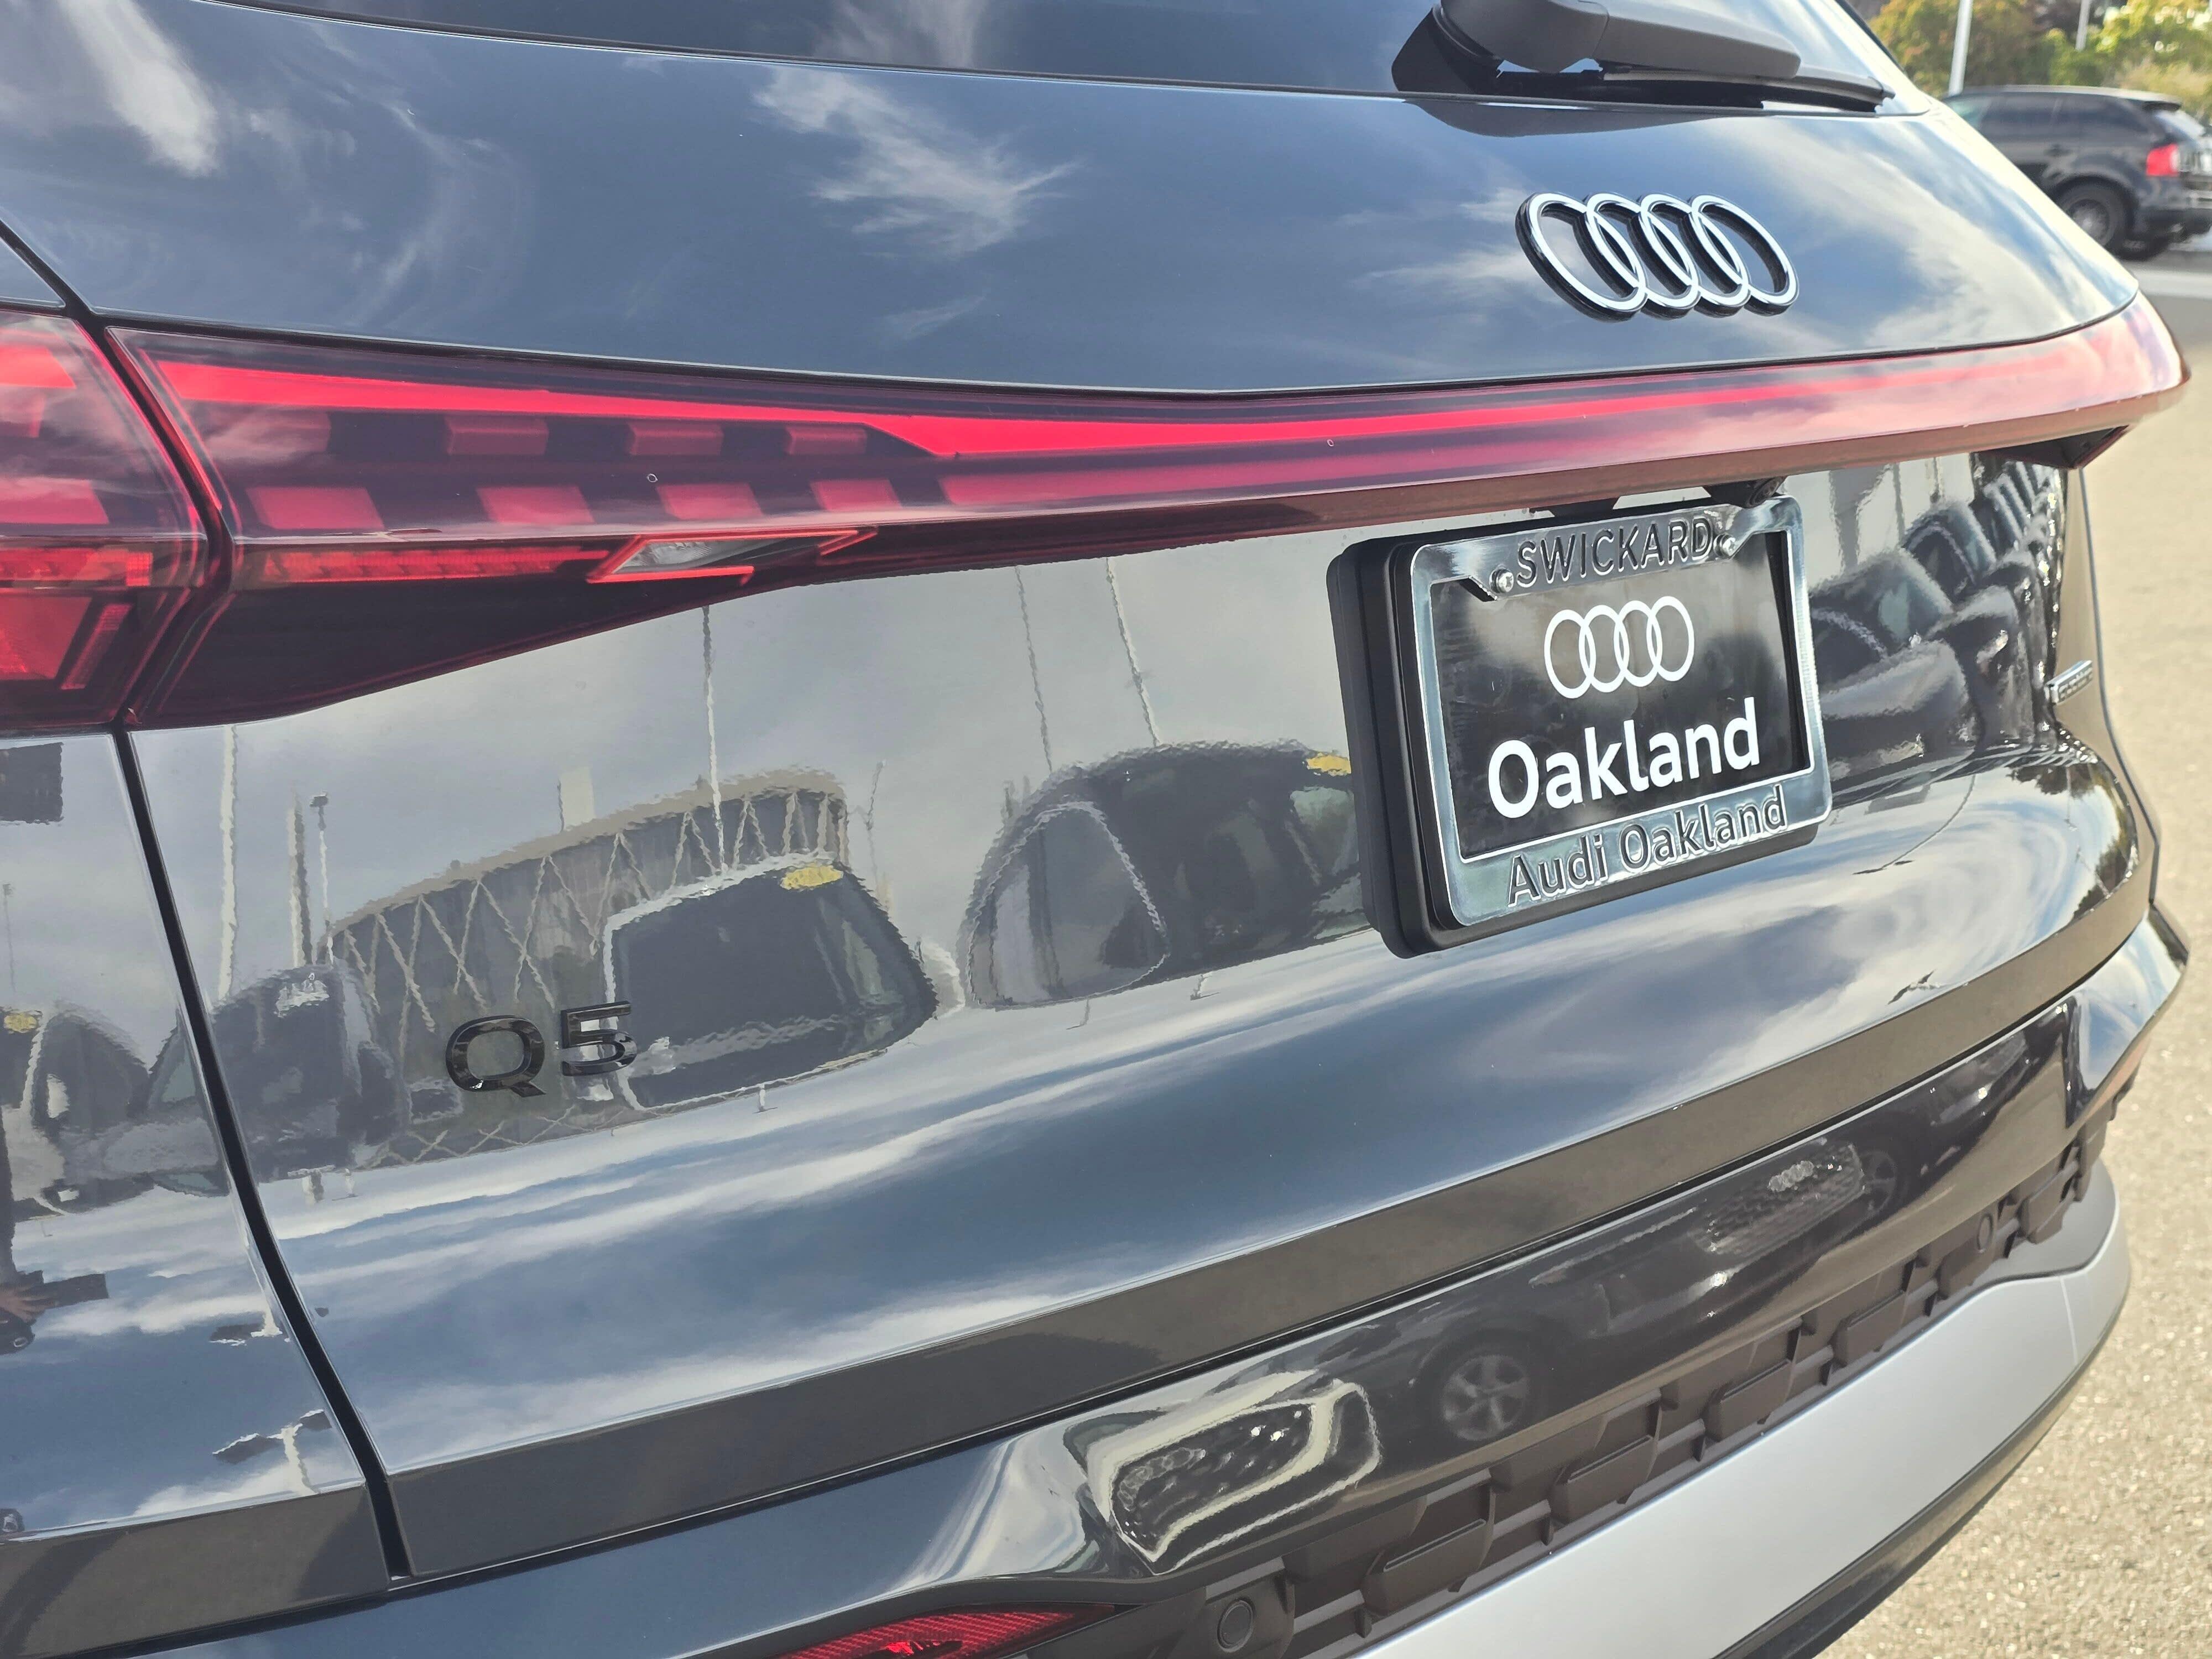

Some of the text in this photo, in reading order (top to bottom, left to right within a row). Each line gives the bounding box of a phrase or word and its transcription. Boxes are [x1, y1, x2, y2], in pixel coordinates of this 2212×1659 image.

[1517, 515, 1715, 588] SWICKARD
[1488, 697, 1760, 818] Oakland
[1507, 785, 1787, 907] Audi Oakland
[446, 1000, 637, 1098] Q5
